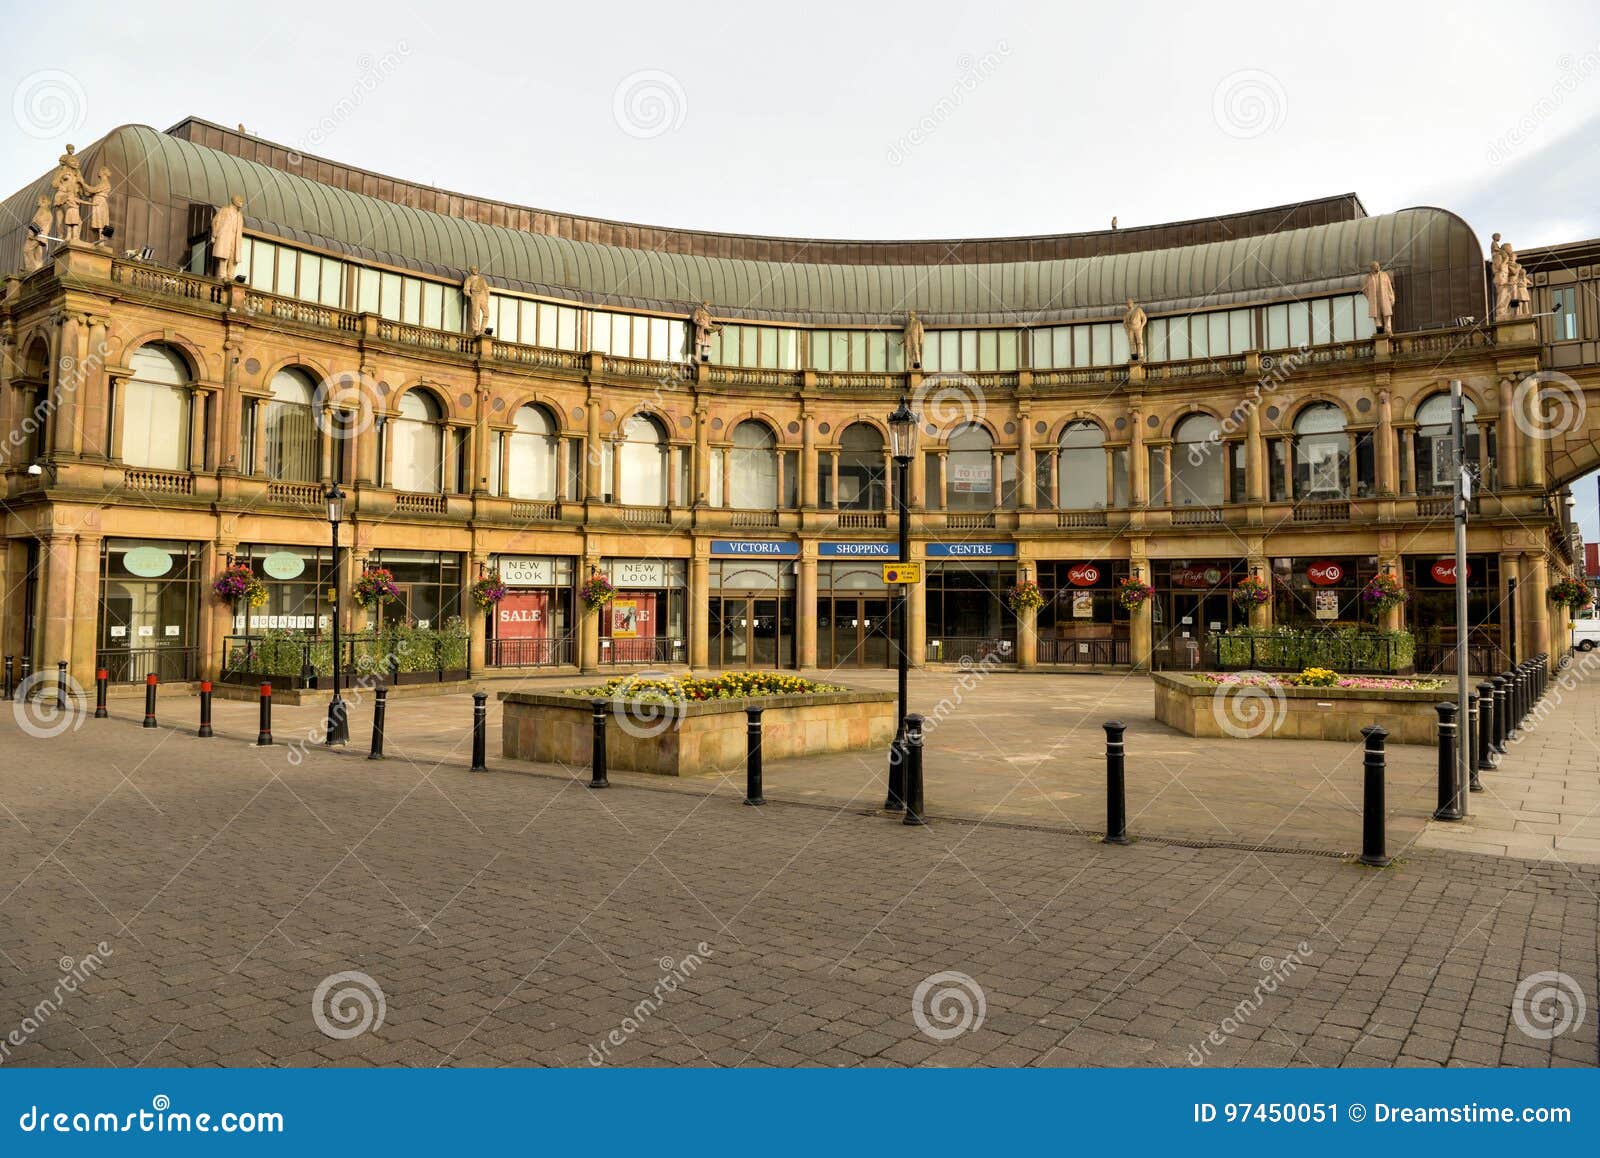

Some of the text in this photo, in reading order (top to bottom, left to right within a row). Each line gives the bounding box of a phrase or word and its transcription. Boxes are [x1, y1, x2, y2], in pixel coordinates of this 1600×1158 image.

[729, 542, 781, 553] VICTORIA
[836, 544, 889, 554] SHOPPING
[949, 544, 993, 555] CENTRE
[508, 561, 540, 569] NEW
[624, 564, 655, 572] NEW
[505, 571, 543, 580] LOOK
[621, 574, 657, 582] LOOK
[1327, 568, 1338, 579] M
[500, 610, 542, 622] SALE
